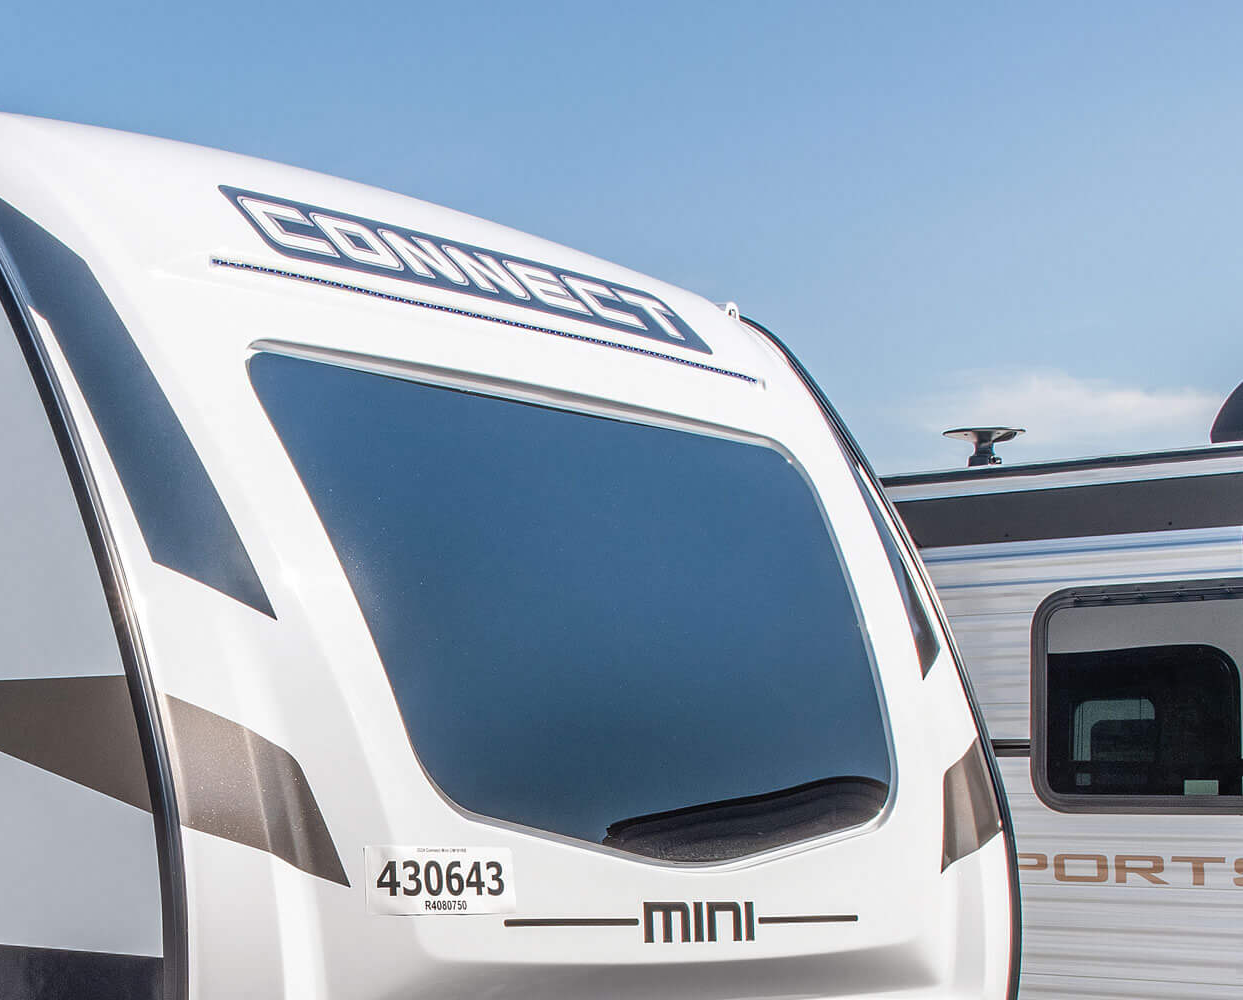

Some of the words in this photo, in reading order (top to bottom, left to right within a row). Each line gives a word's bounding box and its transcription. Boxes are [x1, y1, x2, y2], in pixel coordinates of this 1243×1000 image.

[237, 195, 686, 341] CONNECT
[376, 860, 505, 897] 430643
[1018, 853, 1243, 887] PORT
[424, 900, 468, 911] R4080750
